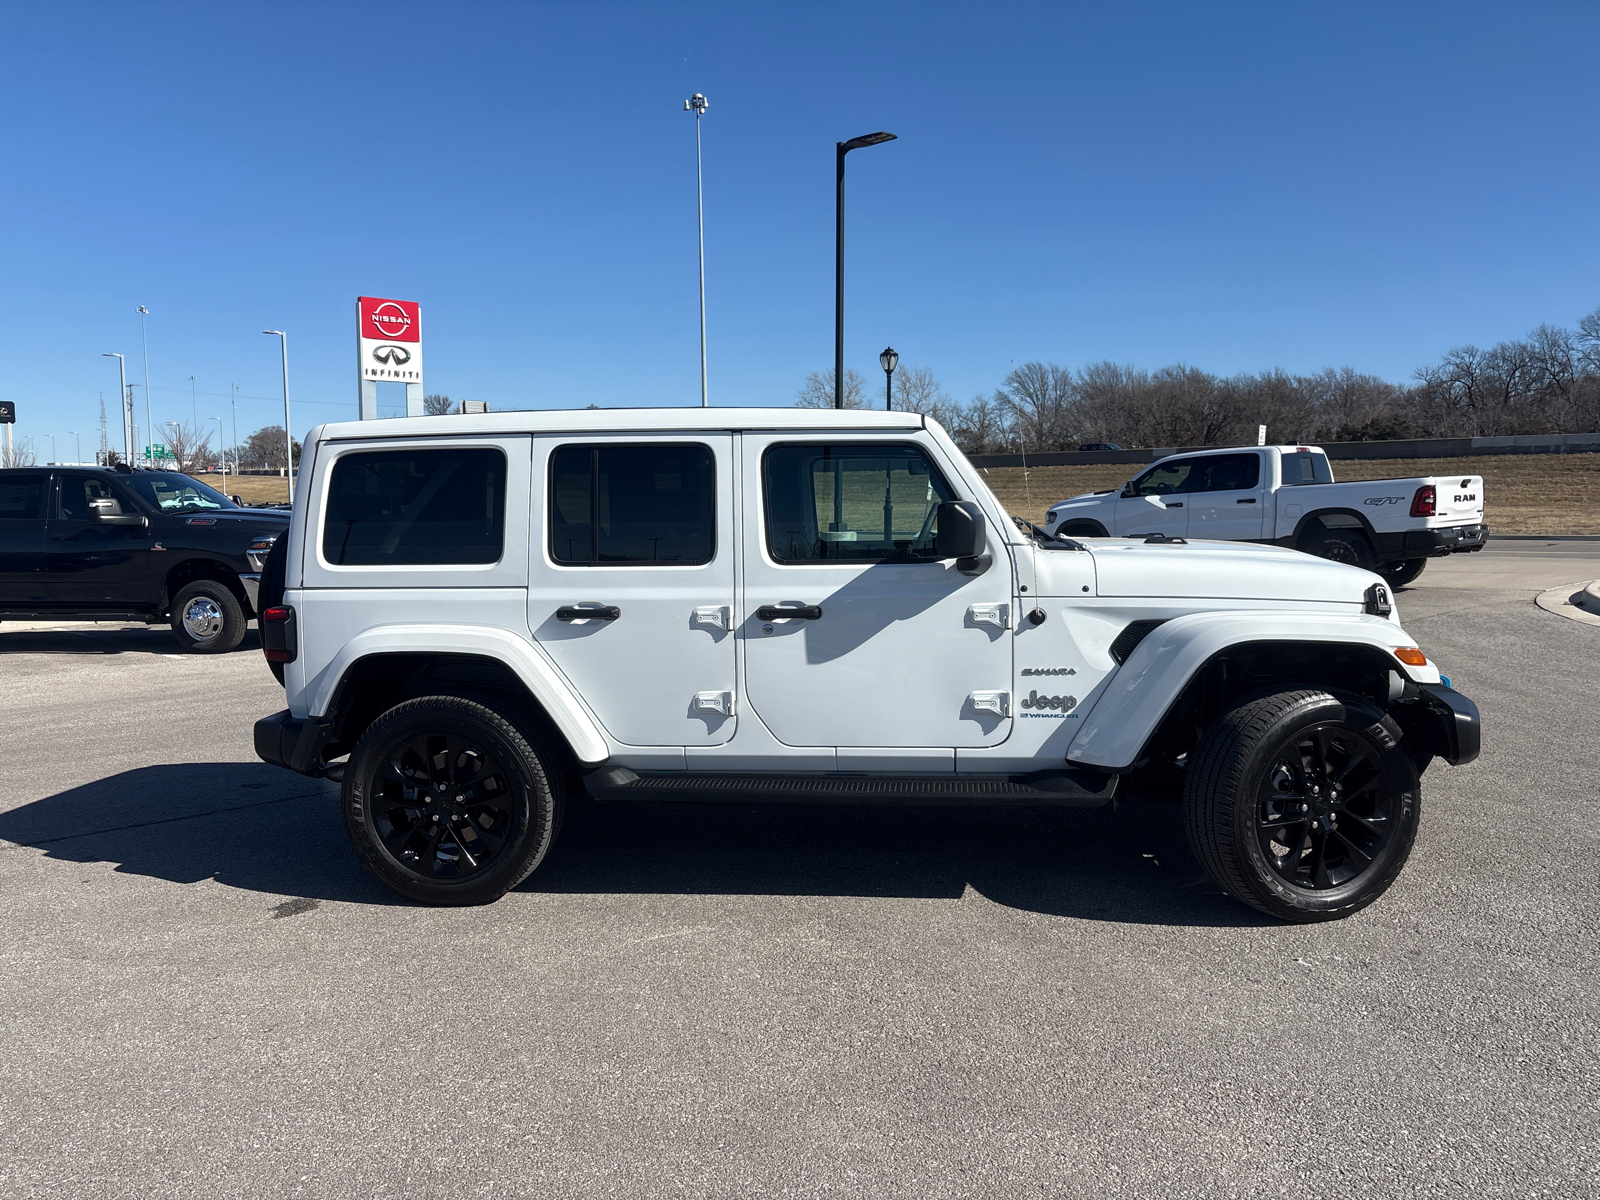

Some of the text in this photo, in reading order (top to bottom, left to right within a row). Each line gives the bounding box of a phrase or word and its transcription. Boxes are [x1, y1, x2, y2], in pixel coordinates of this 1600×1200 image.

[372, 314, 411, 324] NISSAN
[365, 368, 419, 379] INFINITI
[1453, 494, 1476, 503] RAM
[1020, 668, 1077, 676] SAHARA
[1020, 689, 1077, 713] Jeep
